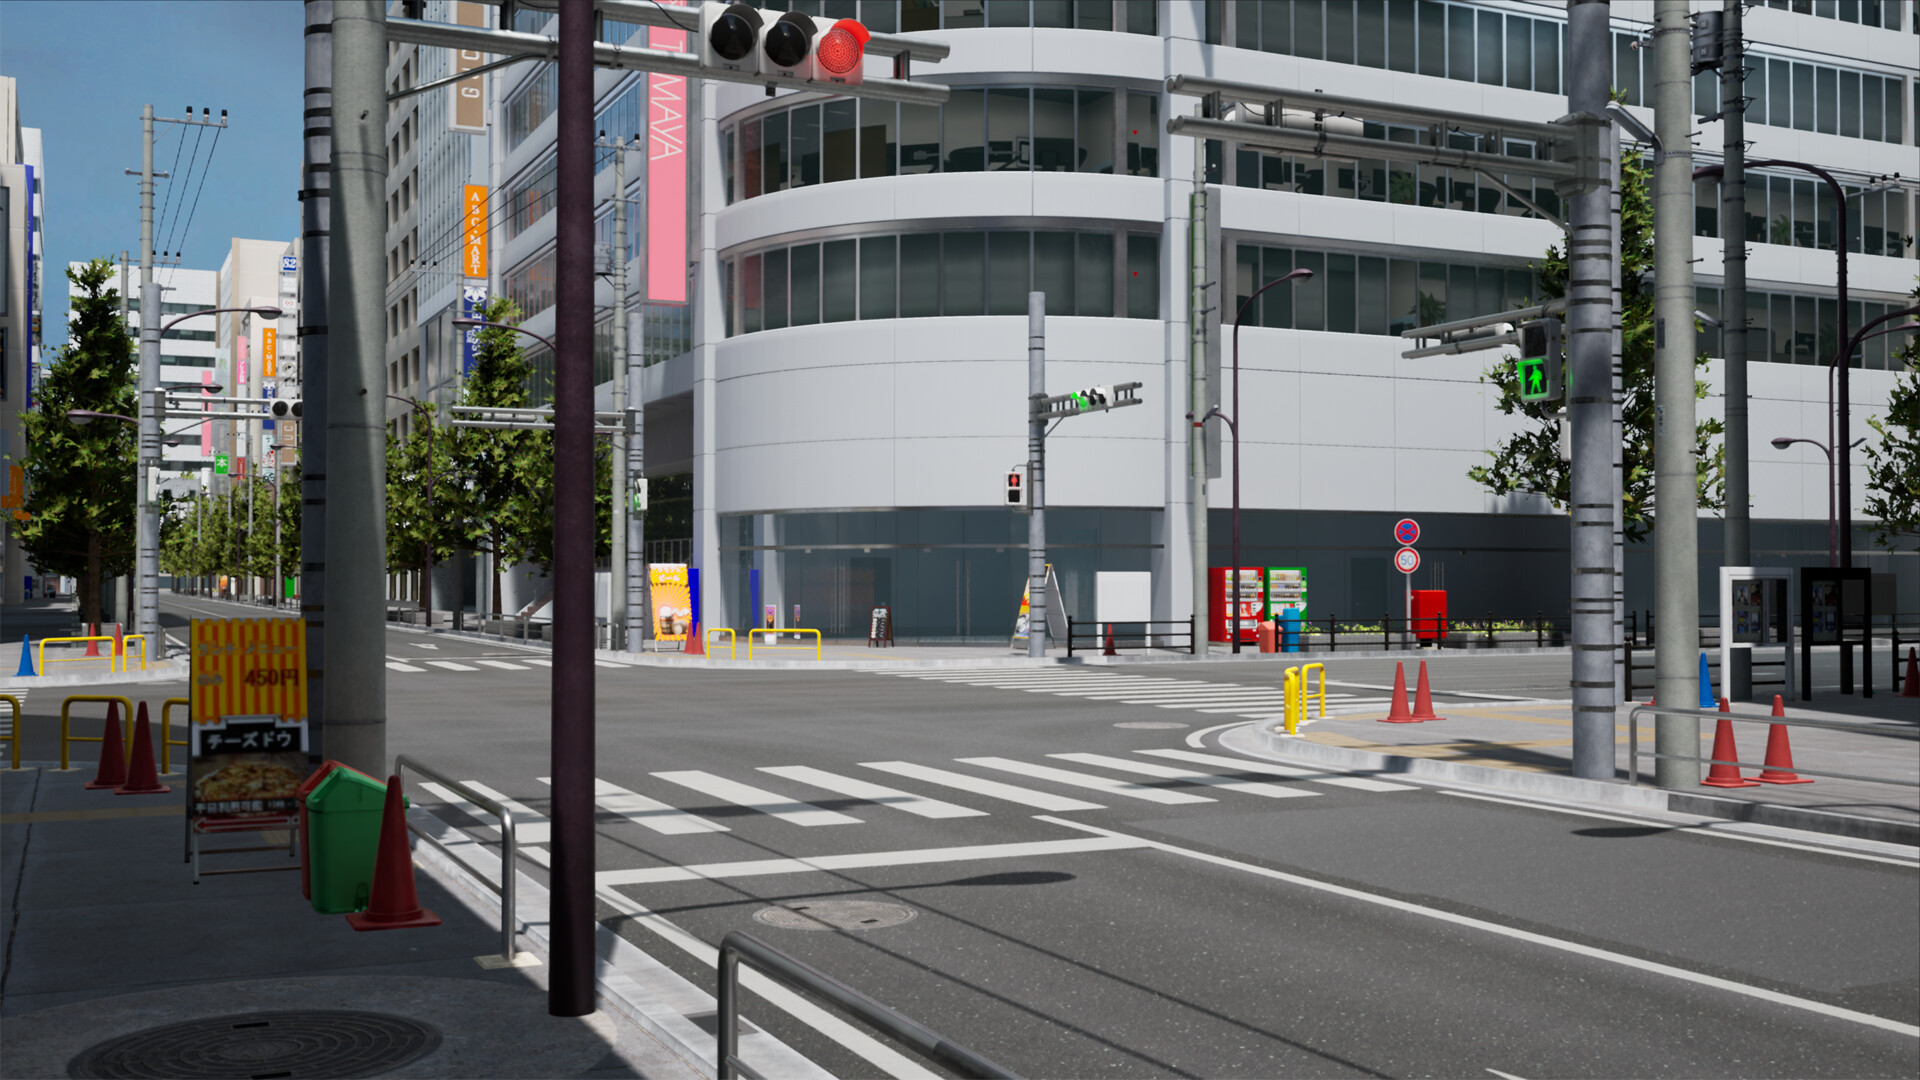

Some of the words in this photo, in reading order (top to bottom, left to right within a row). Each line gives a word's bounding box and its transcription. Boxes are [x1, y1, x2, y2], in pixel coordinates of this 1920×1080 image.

[650, 40, 683, 161] TMAYA
[283, 257, 296, 268] 82
[1400, 555, 1415, 566] 50
[244, 669, 299, 687] 450円
[207, 730, 292, 750] チーズドウ
